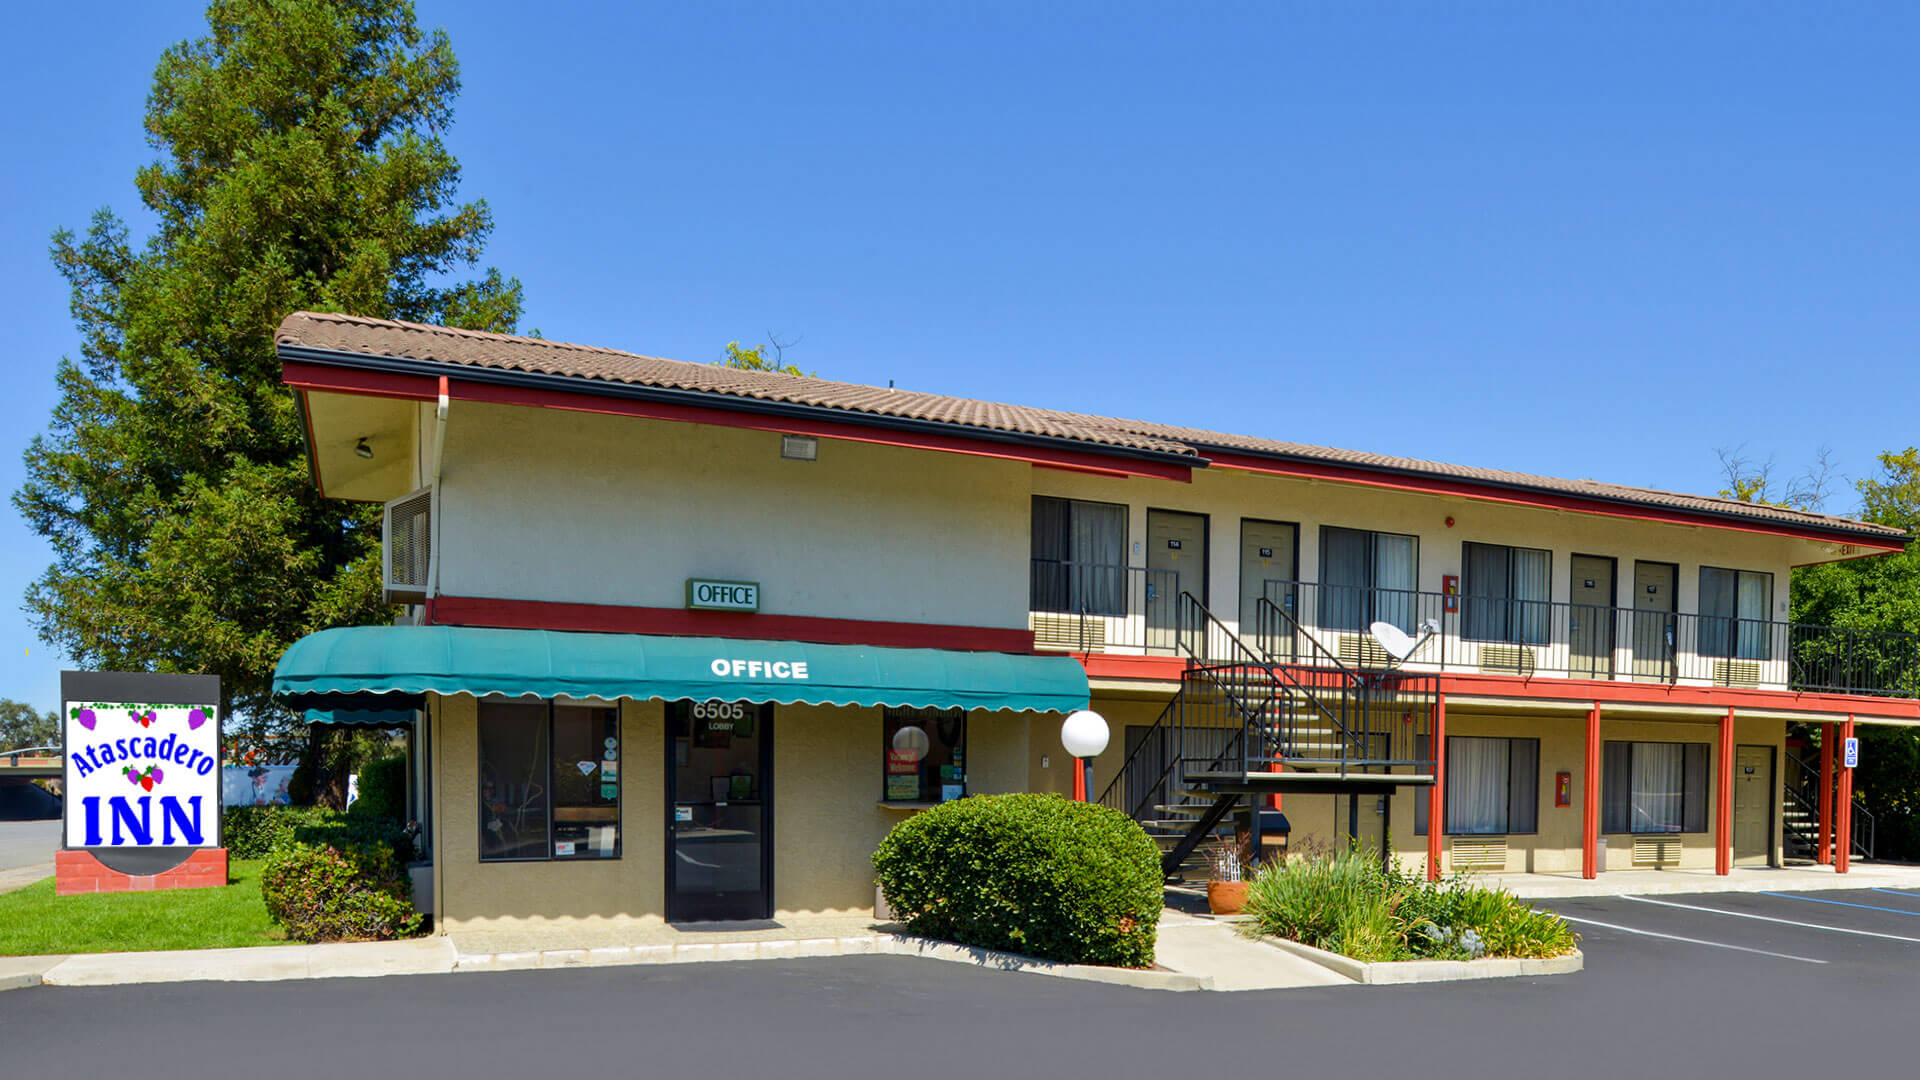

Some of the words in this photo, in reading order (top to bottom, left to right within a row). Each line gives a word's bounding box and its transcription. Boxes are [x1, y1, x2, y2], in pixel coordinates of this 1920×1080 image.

[698, 584, 753, 605] OFFICE
[711, 659, 809, 679] OFFICE
[694, 703, 744, 719] 6505
[708, 722, 735, 730] LOBBY
[71, 733, 214, 778] Atascadero
[82, 796, 204, 845] INN
